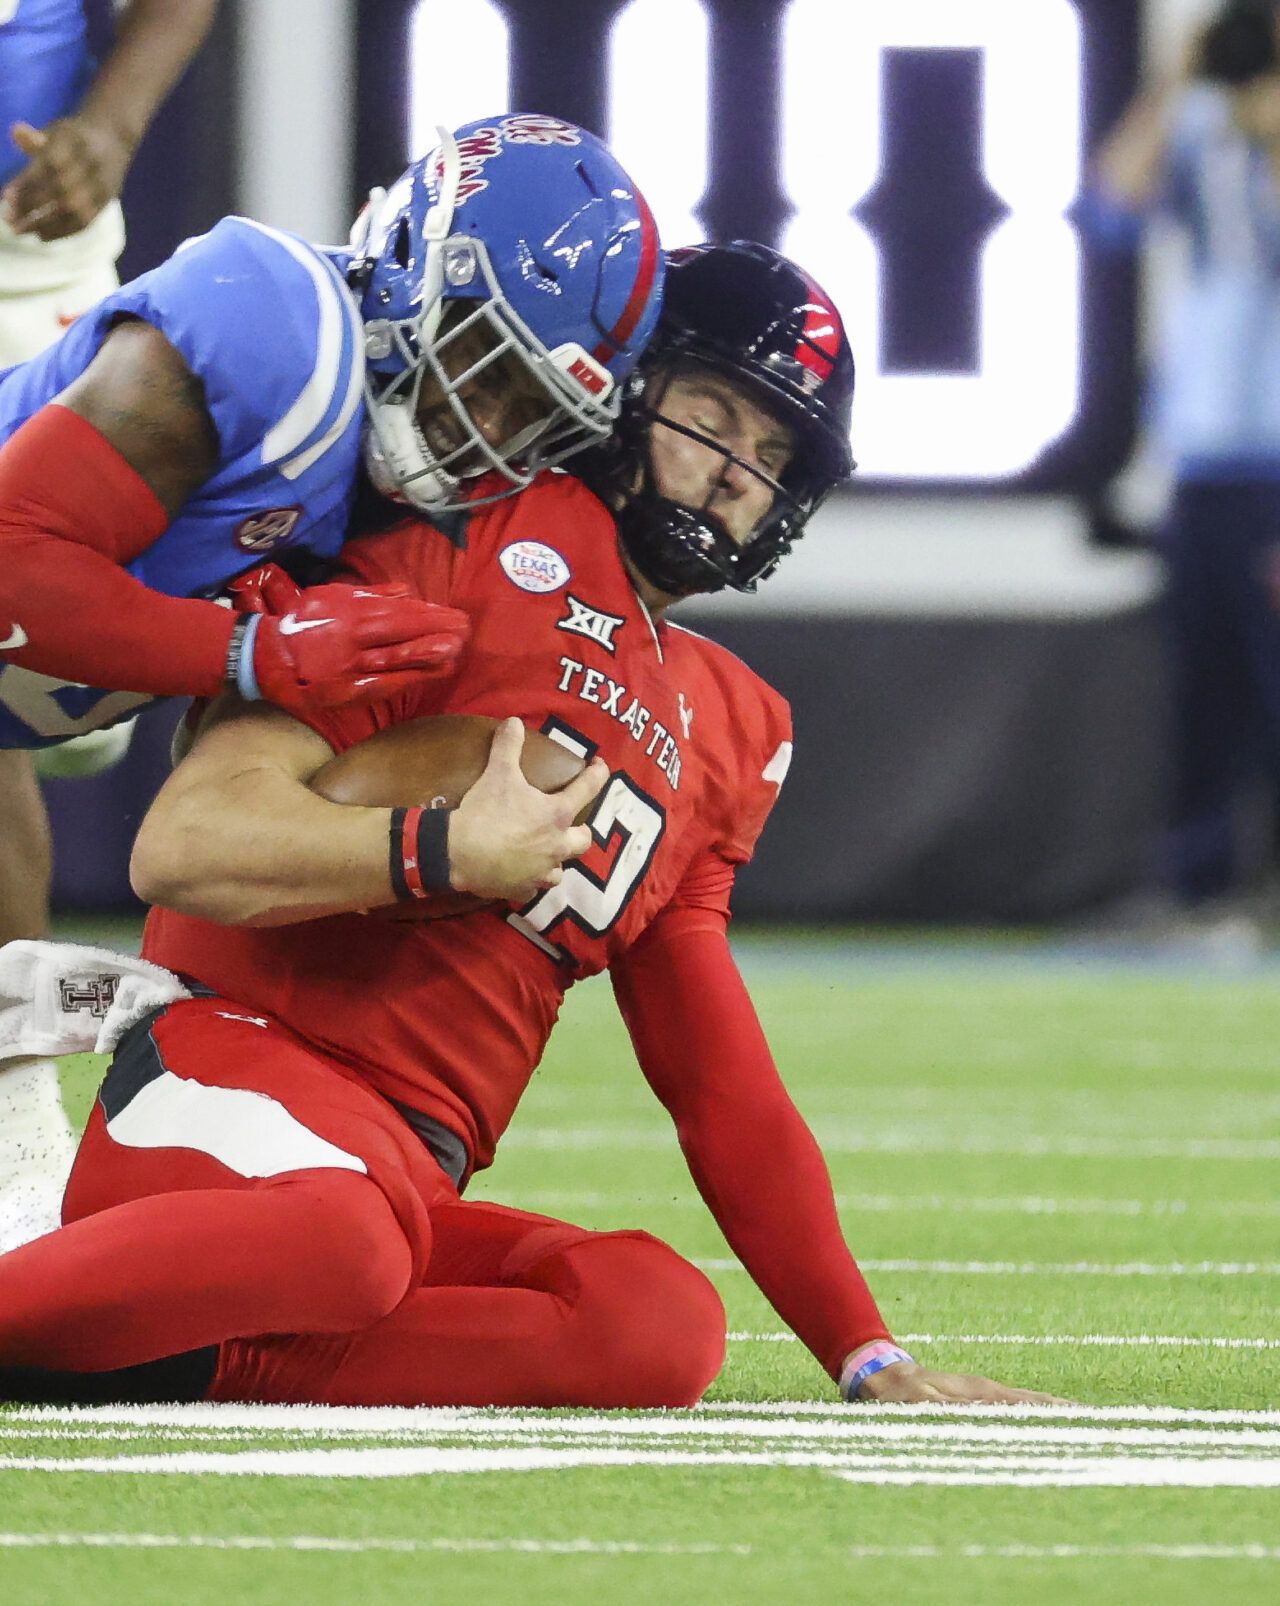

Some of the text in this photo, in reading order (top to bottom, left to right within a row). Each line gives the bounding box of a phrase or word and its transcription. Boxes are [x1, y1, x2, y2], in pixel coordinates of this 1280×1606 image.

[511, 552, 557, 580] TEXAS
[556, 595, 625, 653] XII
[558, 656, 682, 791] TEXAS TECH
